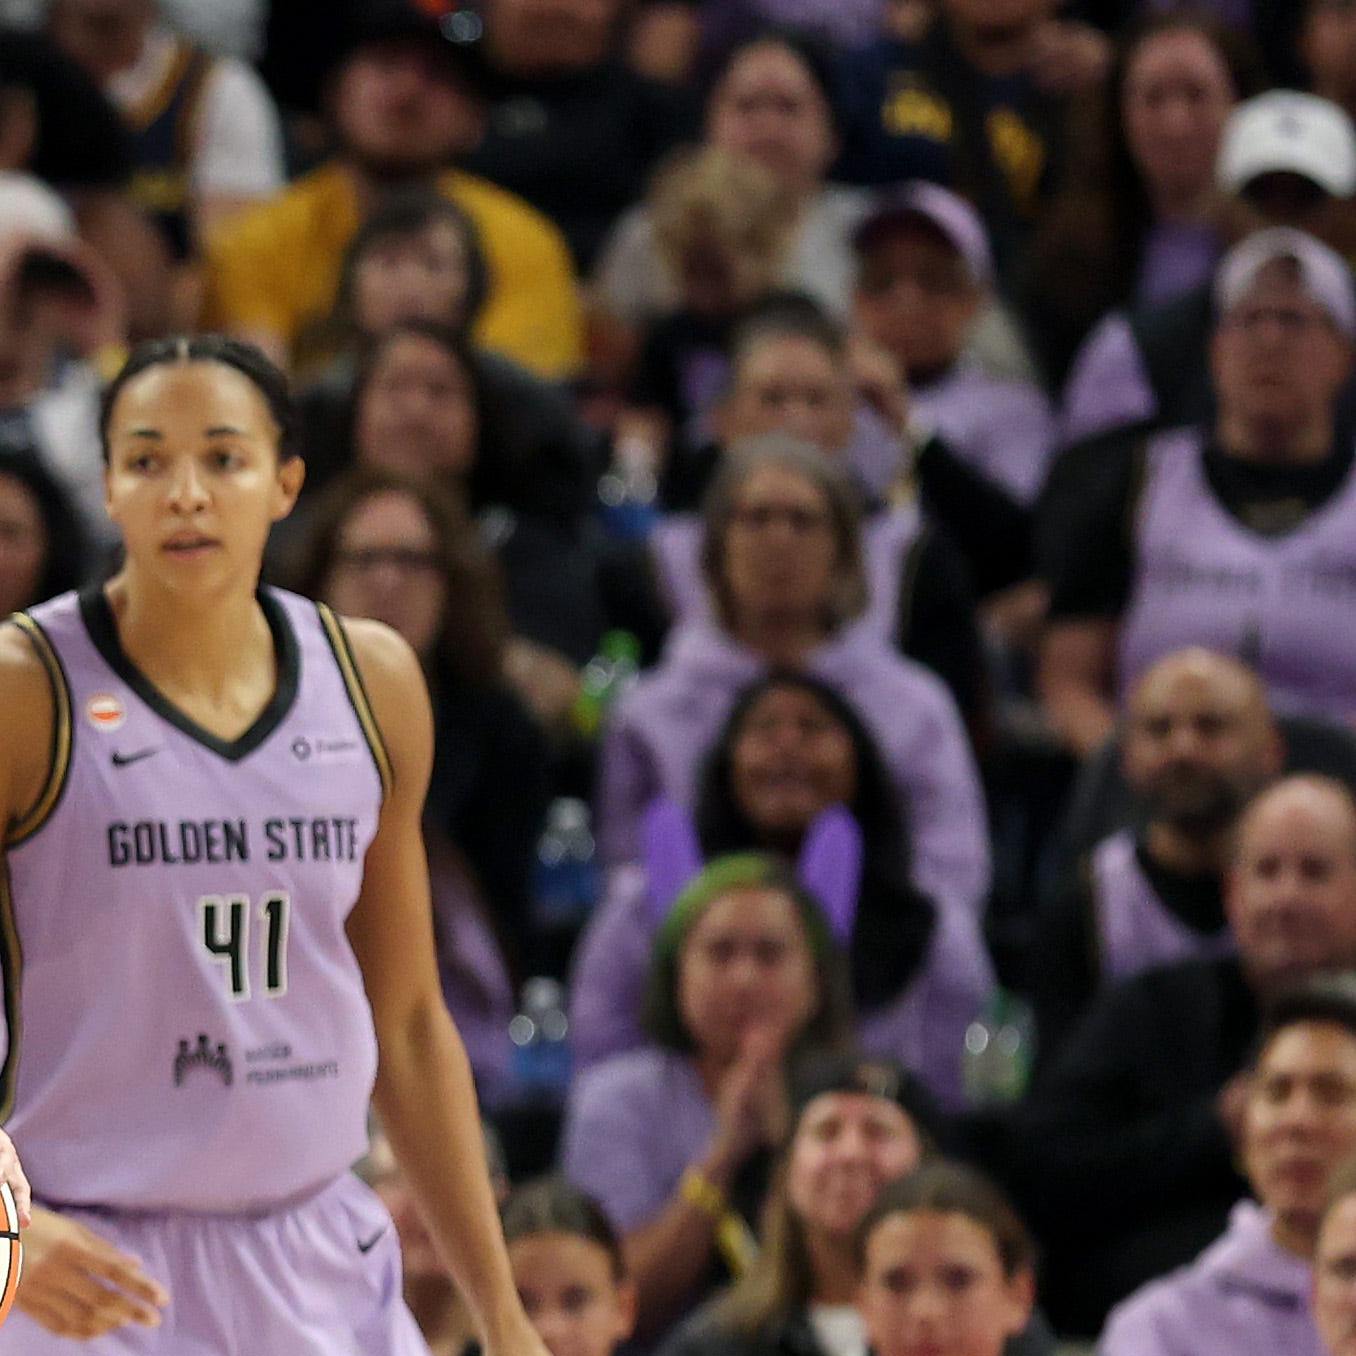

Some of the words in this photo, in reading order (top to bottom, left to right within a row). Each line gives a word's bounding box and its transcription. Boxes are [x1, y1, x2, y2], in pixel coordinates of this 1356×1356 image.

[107, 817, 250, 867] GOLDEN
[265, 817, 359, 863] STATE
[199, 893, 289, 1001] 41
